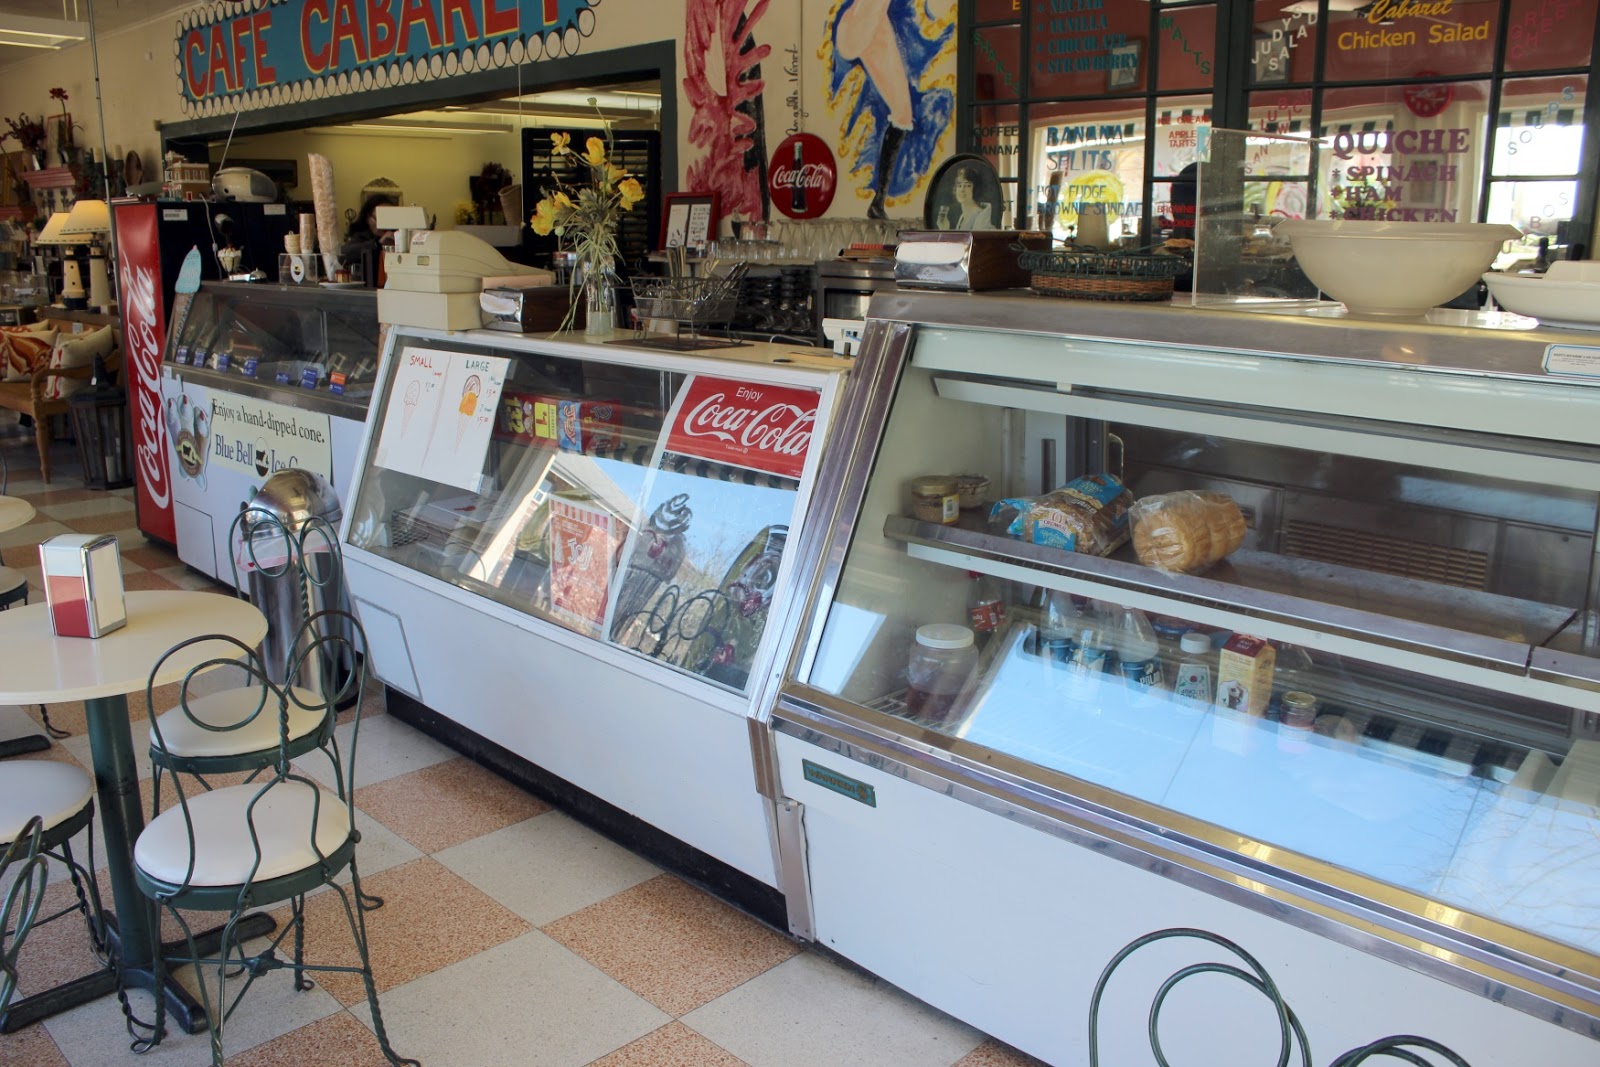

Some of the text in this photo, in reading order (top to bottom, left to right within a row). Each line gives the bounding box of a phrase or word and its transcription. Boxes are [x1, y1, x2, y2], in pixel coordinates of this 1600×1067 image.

[1050, 14, 1107, 33] VANILLA
[300, 0, 560, 74] CABAR
[1160, 16, 1210, 75] MALTS
[1269, 12, 1318, 71] SALAD
[1338, 21, 1489, 50] Chicken Salad
[1048, 53, 1138, 73] STRAWBERRY
[1508, 86, 1577, 156] SOUPS
[1046, 124, 1125, 146] BANANA
[1169, 139, 1197, 148] TARTS
[1333, 128, 1470, 160] QUICHE
[974, 145, 1019, 155] ANANA
[1046, 150, 1113, 171] SPLITS
[772, 163, 825, 189] Coca-Cola
[1346, 165, 1457, 182] SPINACH
[1037, 184, 1107, 199] HOT FUDGE
[1345, 186, 1403, 202] HAM
[1342, 208, 1459, 222] CHICKEN
[410, 355, 433, 369] SMALL
[465, 360, 491, 372] LARGE
[122, 250, 170, 509] Coca-Cola
[736, 387, 763, 402] Enjoy
[212, 398, 325, 443] Enjoy a hand-dipped cone.
[684, 393, 816, 456] Coca-Cola
[215, 434, 234, 460] Blue
[236, 440, 254, 466] Bell
